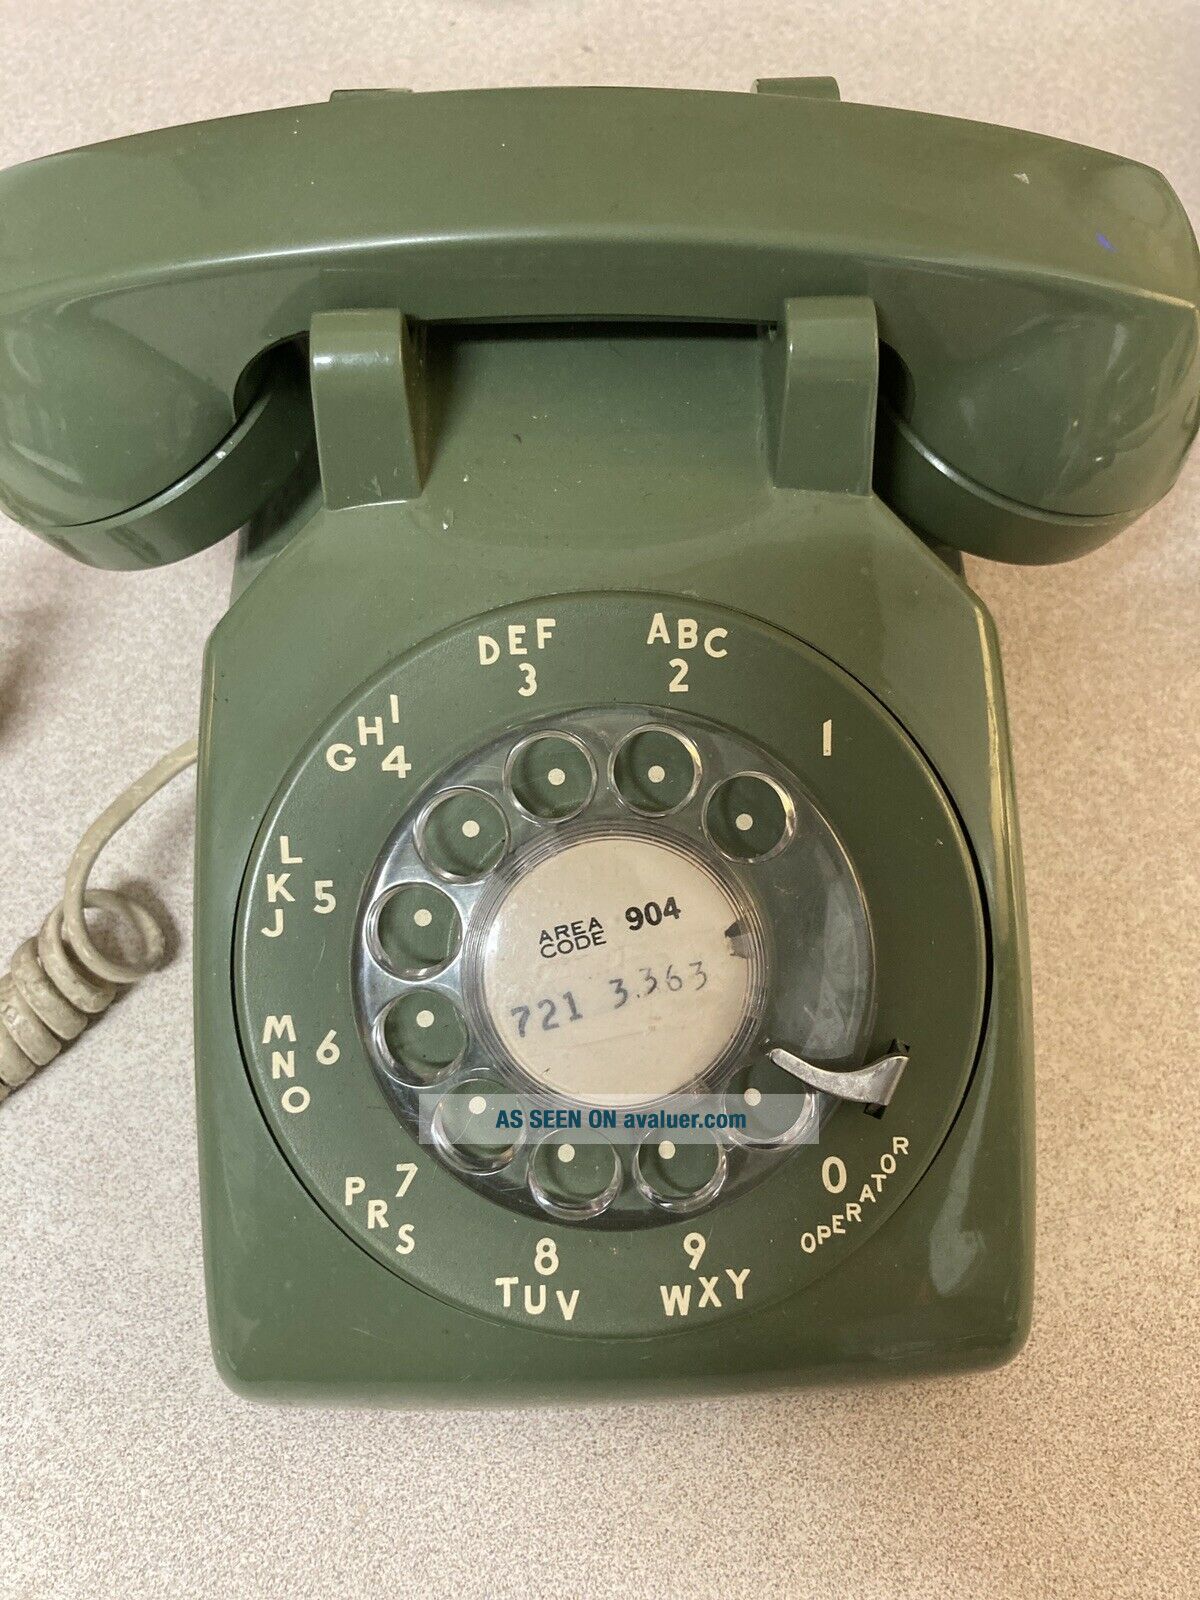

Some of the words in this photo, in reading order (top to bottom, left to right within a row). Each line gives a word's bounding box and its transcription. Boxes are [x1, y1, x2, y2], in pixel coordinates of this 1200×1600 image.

[517, 662, 538, 697] 3
[668, 657, 689, 693] 2
[381, 744, 412, 779] 4
[312, 879, 337, 915] 5
[625, 896, 681, 931] 904
[539, 917, 603, 945] AREA
[540, 930, 606, 958] CODE
[510, 990, 583, 1038] 721
[315, 1028, 341, 1066] 6
[395, 1162, 419, 1198] 7
[800, 1136, 909, 1254] OPERATOR
[533, 1237, 560, 1276] 8
[683, 1232, 706, 1271] 9
